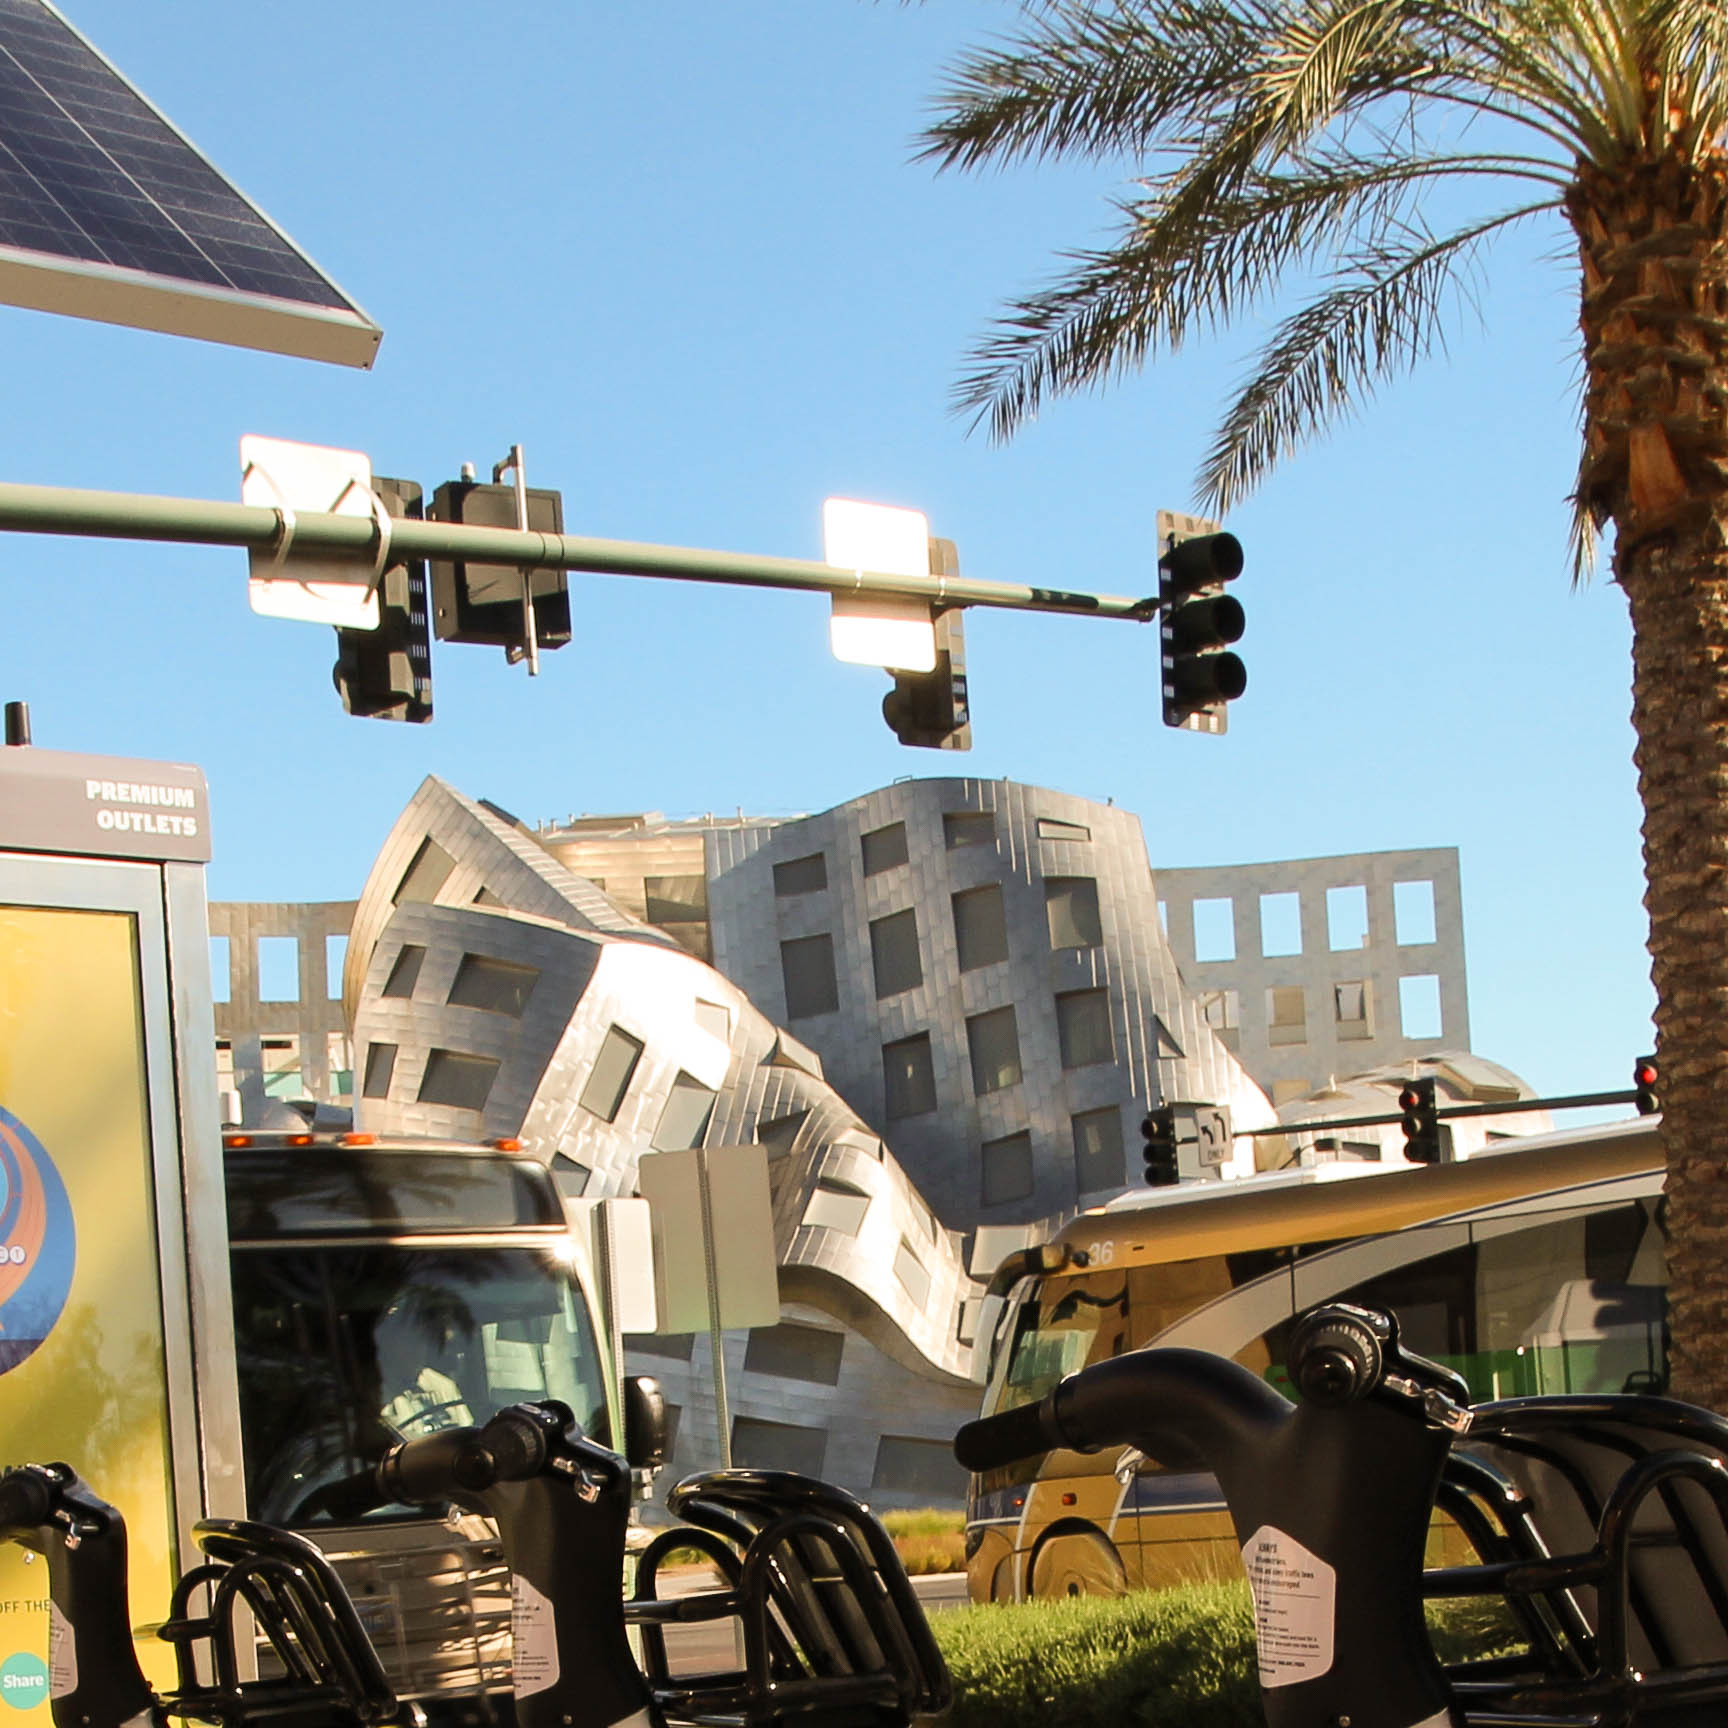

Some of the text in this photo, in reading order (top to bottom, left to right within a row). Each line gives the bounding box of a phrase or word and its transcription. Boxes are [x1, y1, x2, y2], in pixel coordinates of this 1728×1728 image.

[86, 779, 196, 809] PREMIUM
[97, 809, 198, 837] OUTLETS
[2, 1673, 45, 1690] Share
